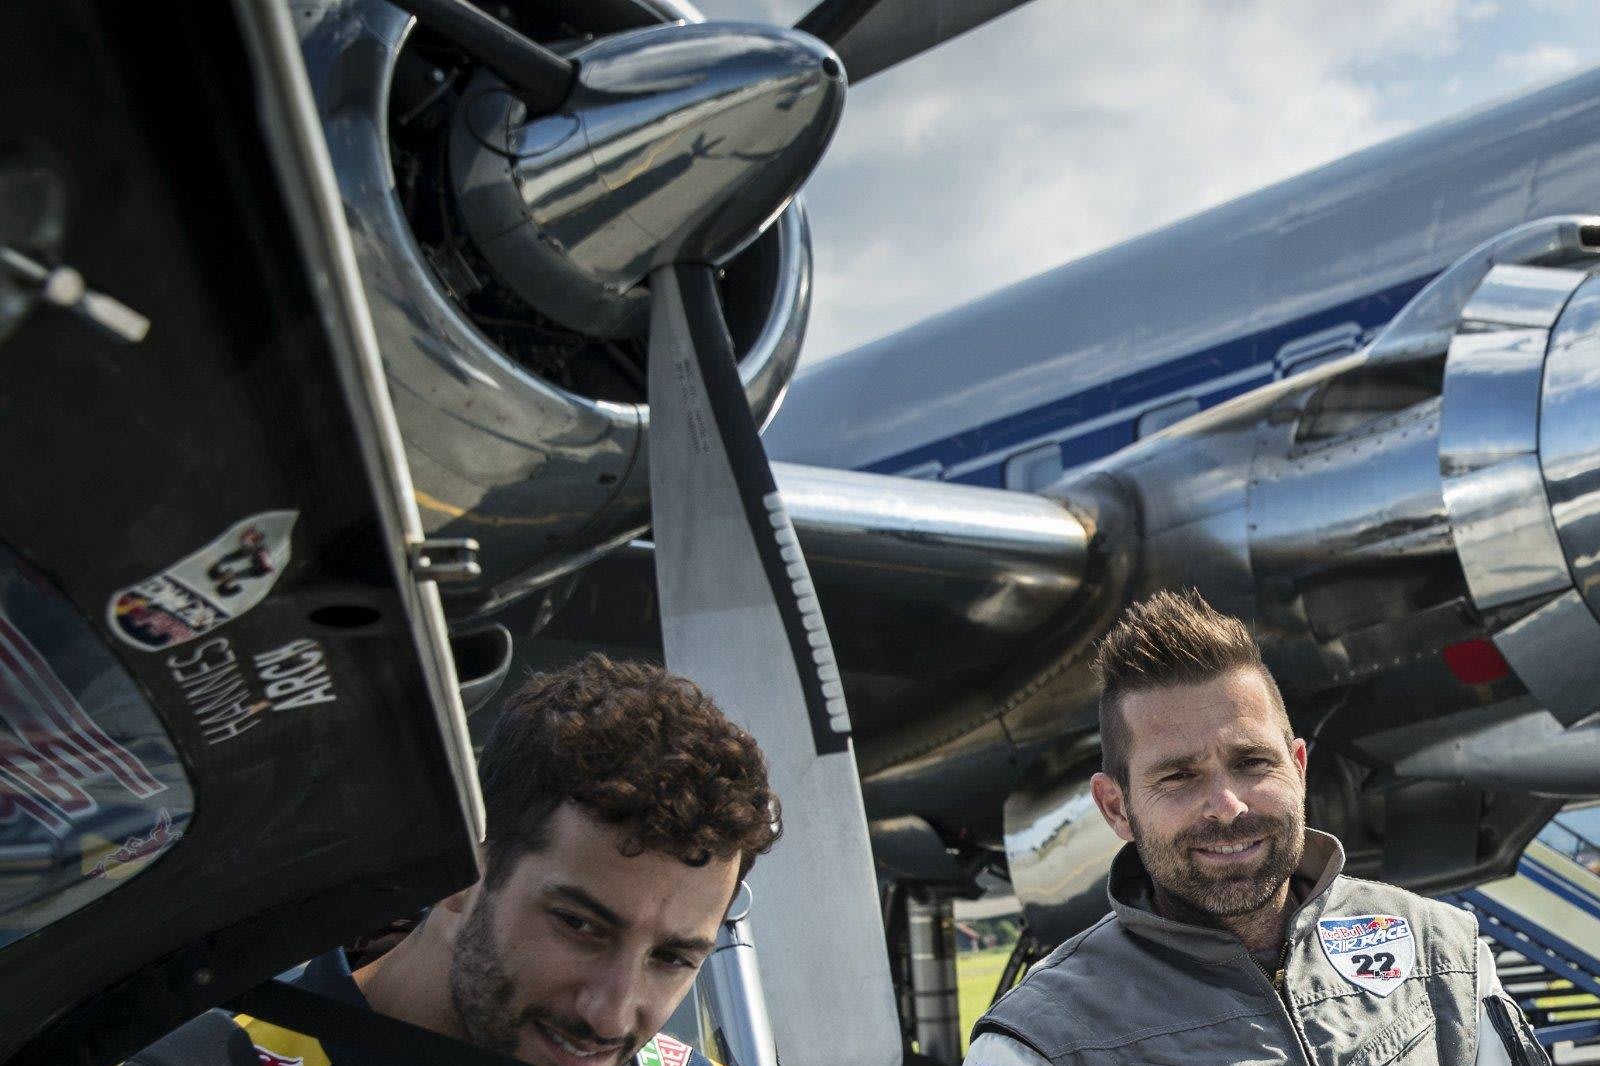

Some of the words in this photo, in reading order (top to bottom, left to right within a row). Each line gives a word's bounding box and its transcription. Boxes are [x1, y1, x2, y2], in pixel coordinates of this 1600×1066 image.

[254, 639, 337, 711] ARCH
[166, 637, 262, 746] HANNES
[1340, 924, 1365, 938] Bull
[1360, 925, 1409, 948] RACE
[1351, 952, 1396, 977] 22
